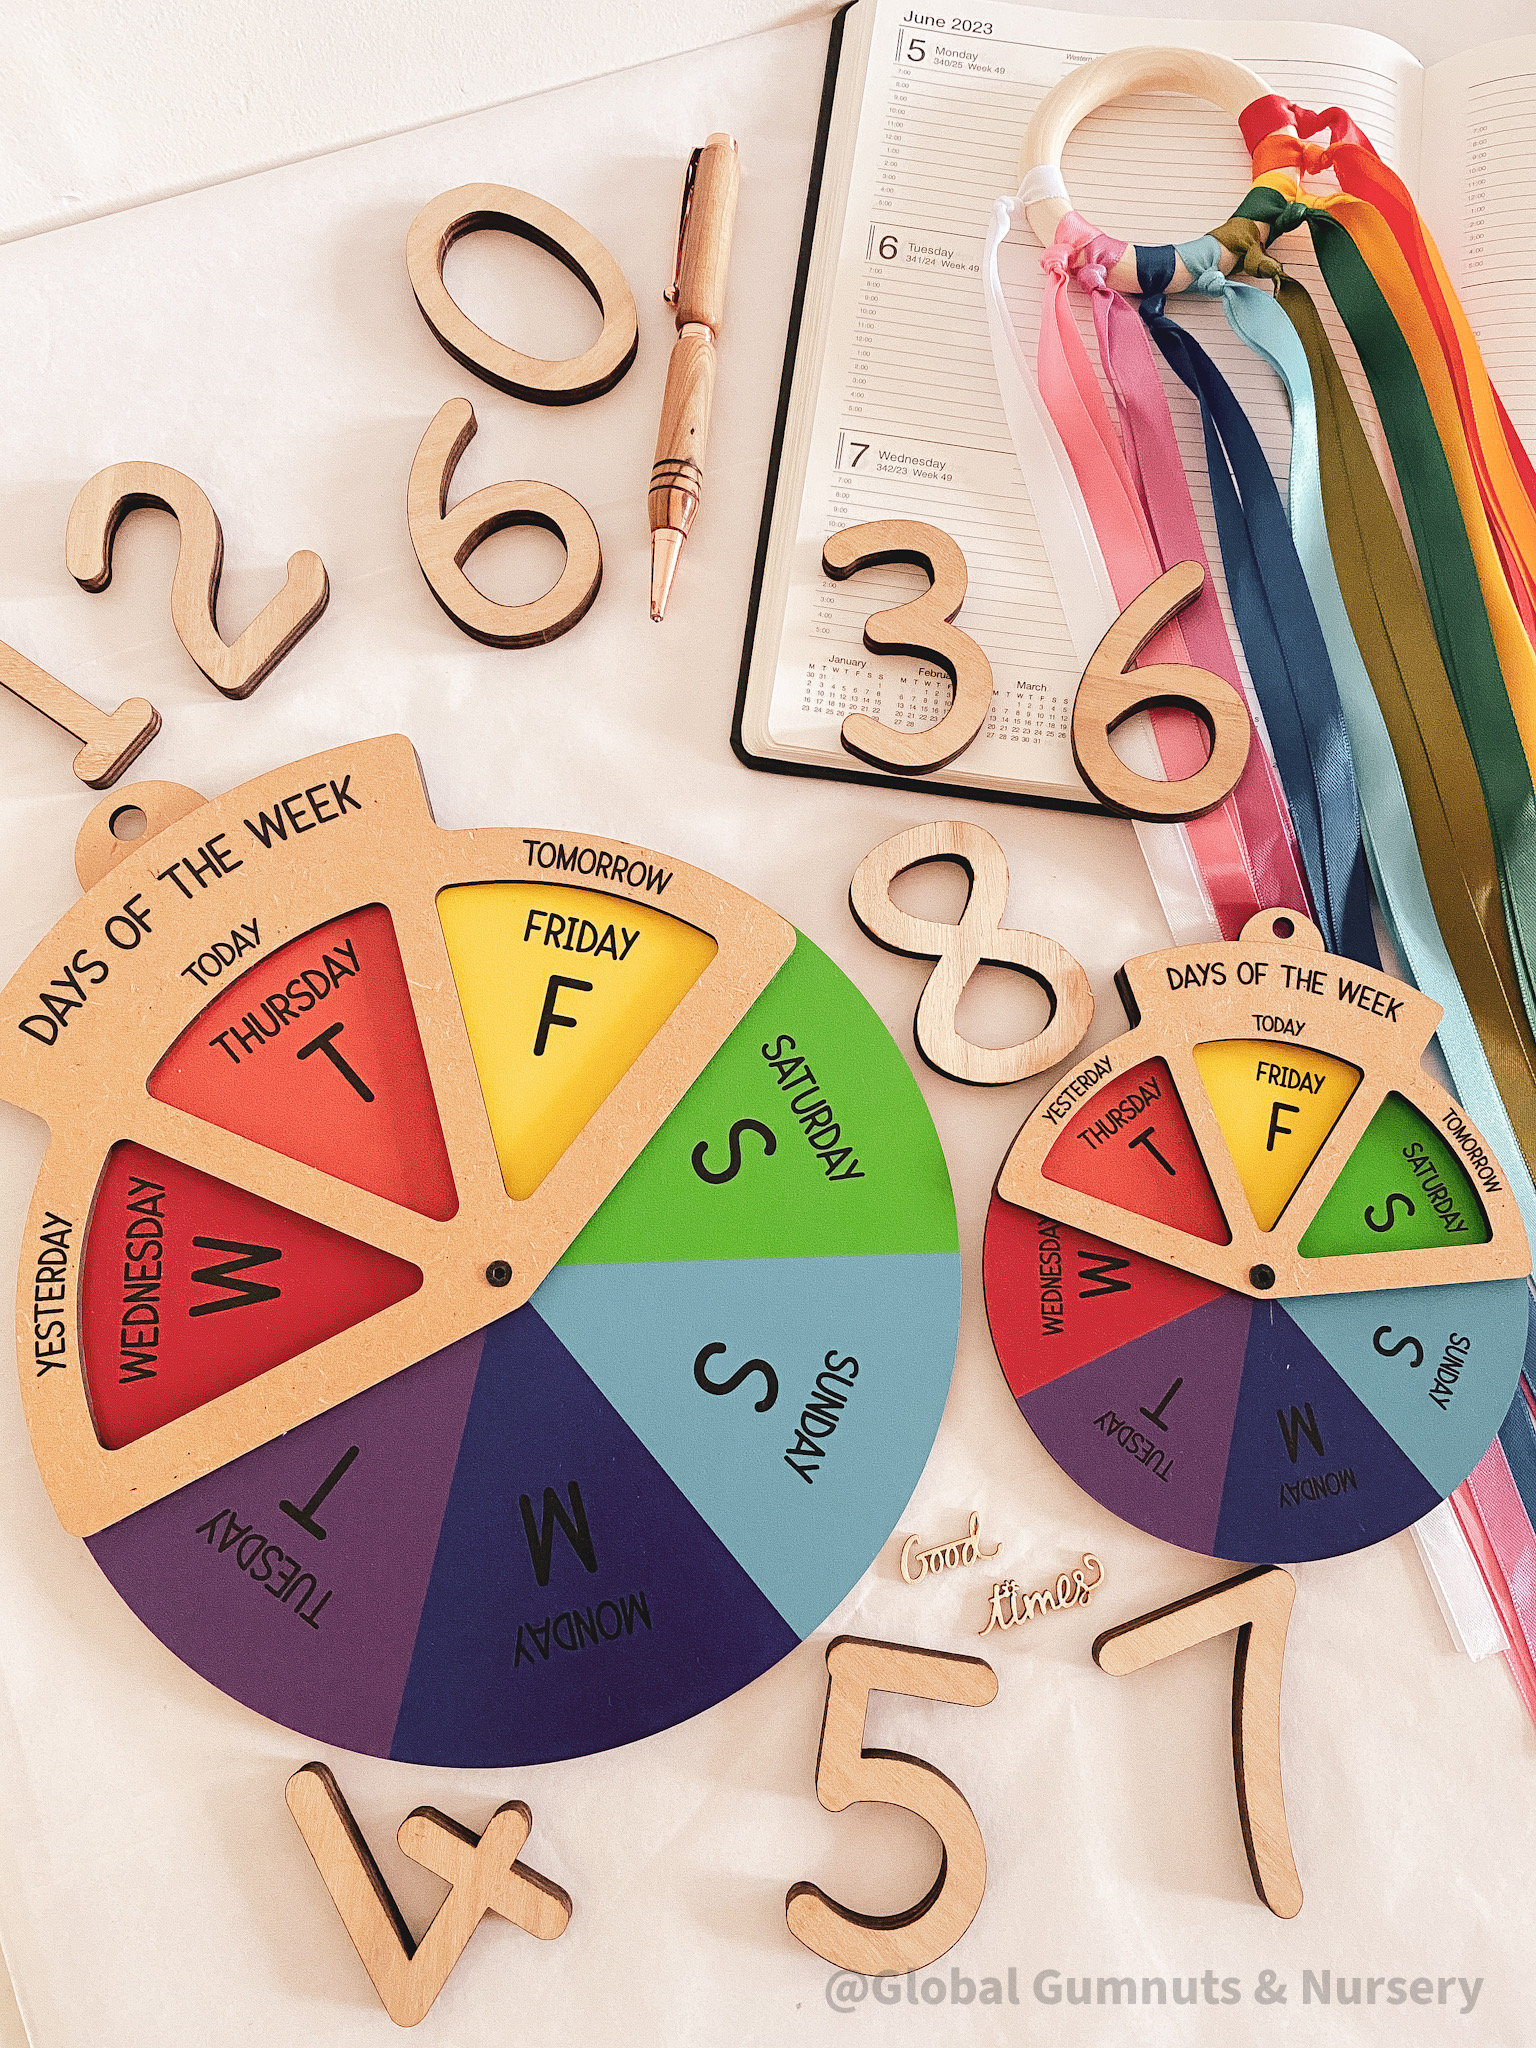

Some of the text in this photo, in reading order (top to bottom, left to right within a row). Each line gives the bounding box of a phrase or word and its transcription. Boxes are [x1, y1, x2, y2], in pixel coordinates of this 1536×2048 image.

[903, 10, 993, 35] June 2023
[907, 38, 926, 62] 5
[935, 46, 979, 62] Monday
[968, 63, 992, 73] Week
[879, 235, 898, 260] 6
[905, 255, 980, 272] 341/24 Week 49
[908, 242, 954, 260] Tuesday
[850, 442, 870, 467] 7
[876, 463, 953, 482] 342/23 Week 49
[879, 450, 946, 471] Wednesday
[407, 397, 603, 650] 6
[65, 461, 330, 700] 2
[822, 519, 993, 776] 3
[828, 655, 867, 669] January
[918, 667, 951, 679] Februa
[1016, 681, 1047, 692] March
[1072, 560, 1251, 823] 6
[523, 839, 673, 894] TOMORROW
[19, 775, 361, 1046] DAYS OF THE WEEK
[523, 909, 640, 960] FRIDAY
[181, 918, 262, 986] TODAY
[849, 820, 1095, 1087] 8
[209, 939, 360, 1064] THURSDAY
[534, 974, 593, 1056] F
[1166, 962, 1404, 1023] DAYS OF THE WEEK
[1252, 1014, 1306, 1036] TODAY
[297, 1022, 374, 1103] T
[1042, 1055, 1113, 1125] YESTERDAY
[1256, 1061, 1325, 1095] FRIDAY
[762, 1034, 865, 1181] SATURDAY
[1077, 1077, 1161, 1149] THURSDAY
[1267, 1102, 1299, 1151] F
[691, 1119, 777, 1184] S
[1128, 1127, 1176, 1176] T
[1442, 1107, 1503, 1193] TOMORROW
[1365, 1193, 1415, 1232] S
[1402, 1142, 1469, 1234] SATURDAY
[34, 1211, 72, 1377] YESTERDAY
[119, 1176, 166, 1384] WEDNESDAY
[189, 1236, 282, 1317] W
[1037, 1214, 1064, 1336] WEDNESDAY
[1078, 1251, 1131, 1298] W
[694, 1342, 778, 1412] S
[1373, 1325, 1424, 1368] S
[1429, 1333, 1471, 1411] SUNDAY
[784, 1350, 859, 1484] SUNDAY
[1140, 1378, 1183, 1431] T
[1277, 1402, 1325, 1463] M
[1093, 1410, 1174, 1482] TUESDAY
[279, 1445, 359, 1540] T
[1280, 1467, 1358, 1507] MONDAY
[519, 1480, 597, 1587] M
[900, 1511, 1002, 1584] Good
[196, 1509, 333, 1629] TUESDAY
[978, 1553, 1104, 1636] times
[514, 1591, 652, 1668] MONDAY
[1092, 1564, 1303, 1919] 7
[785, 1635, 998, 1977] 5
[286, 1761, 572, 2028] 4
